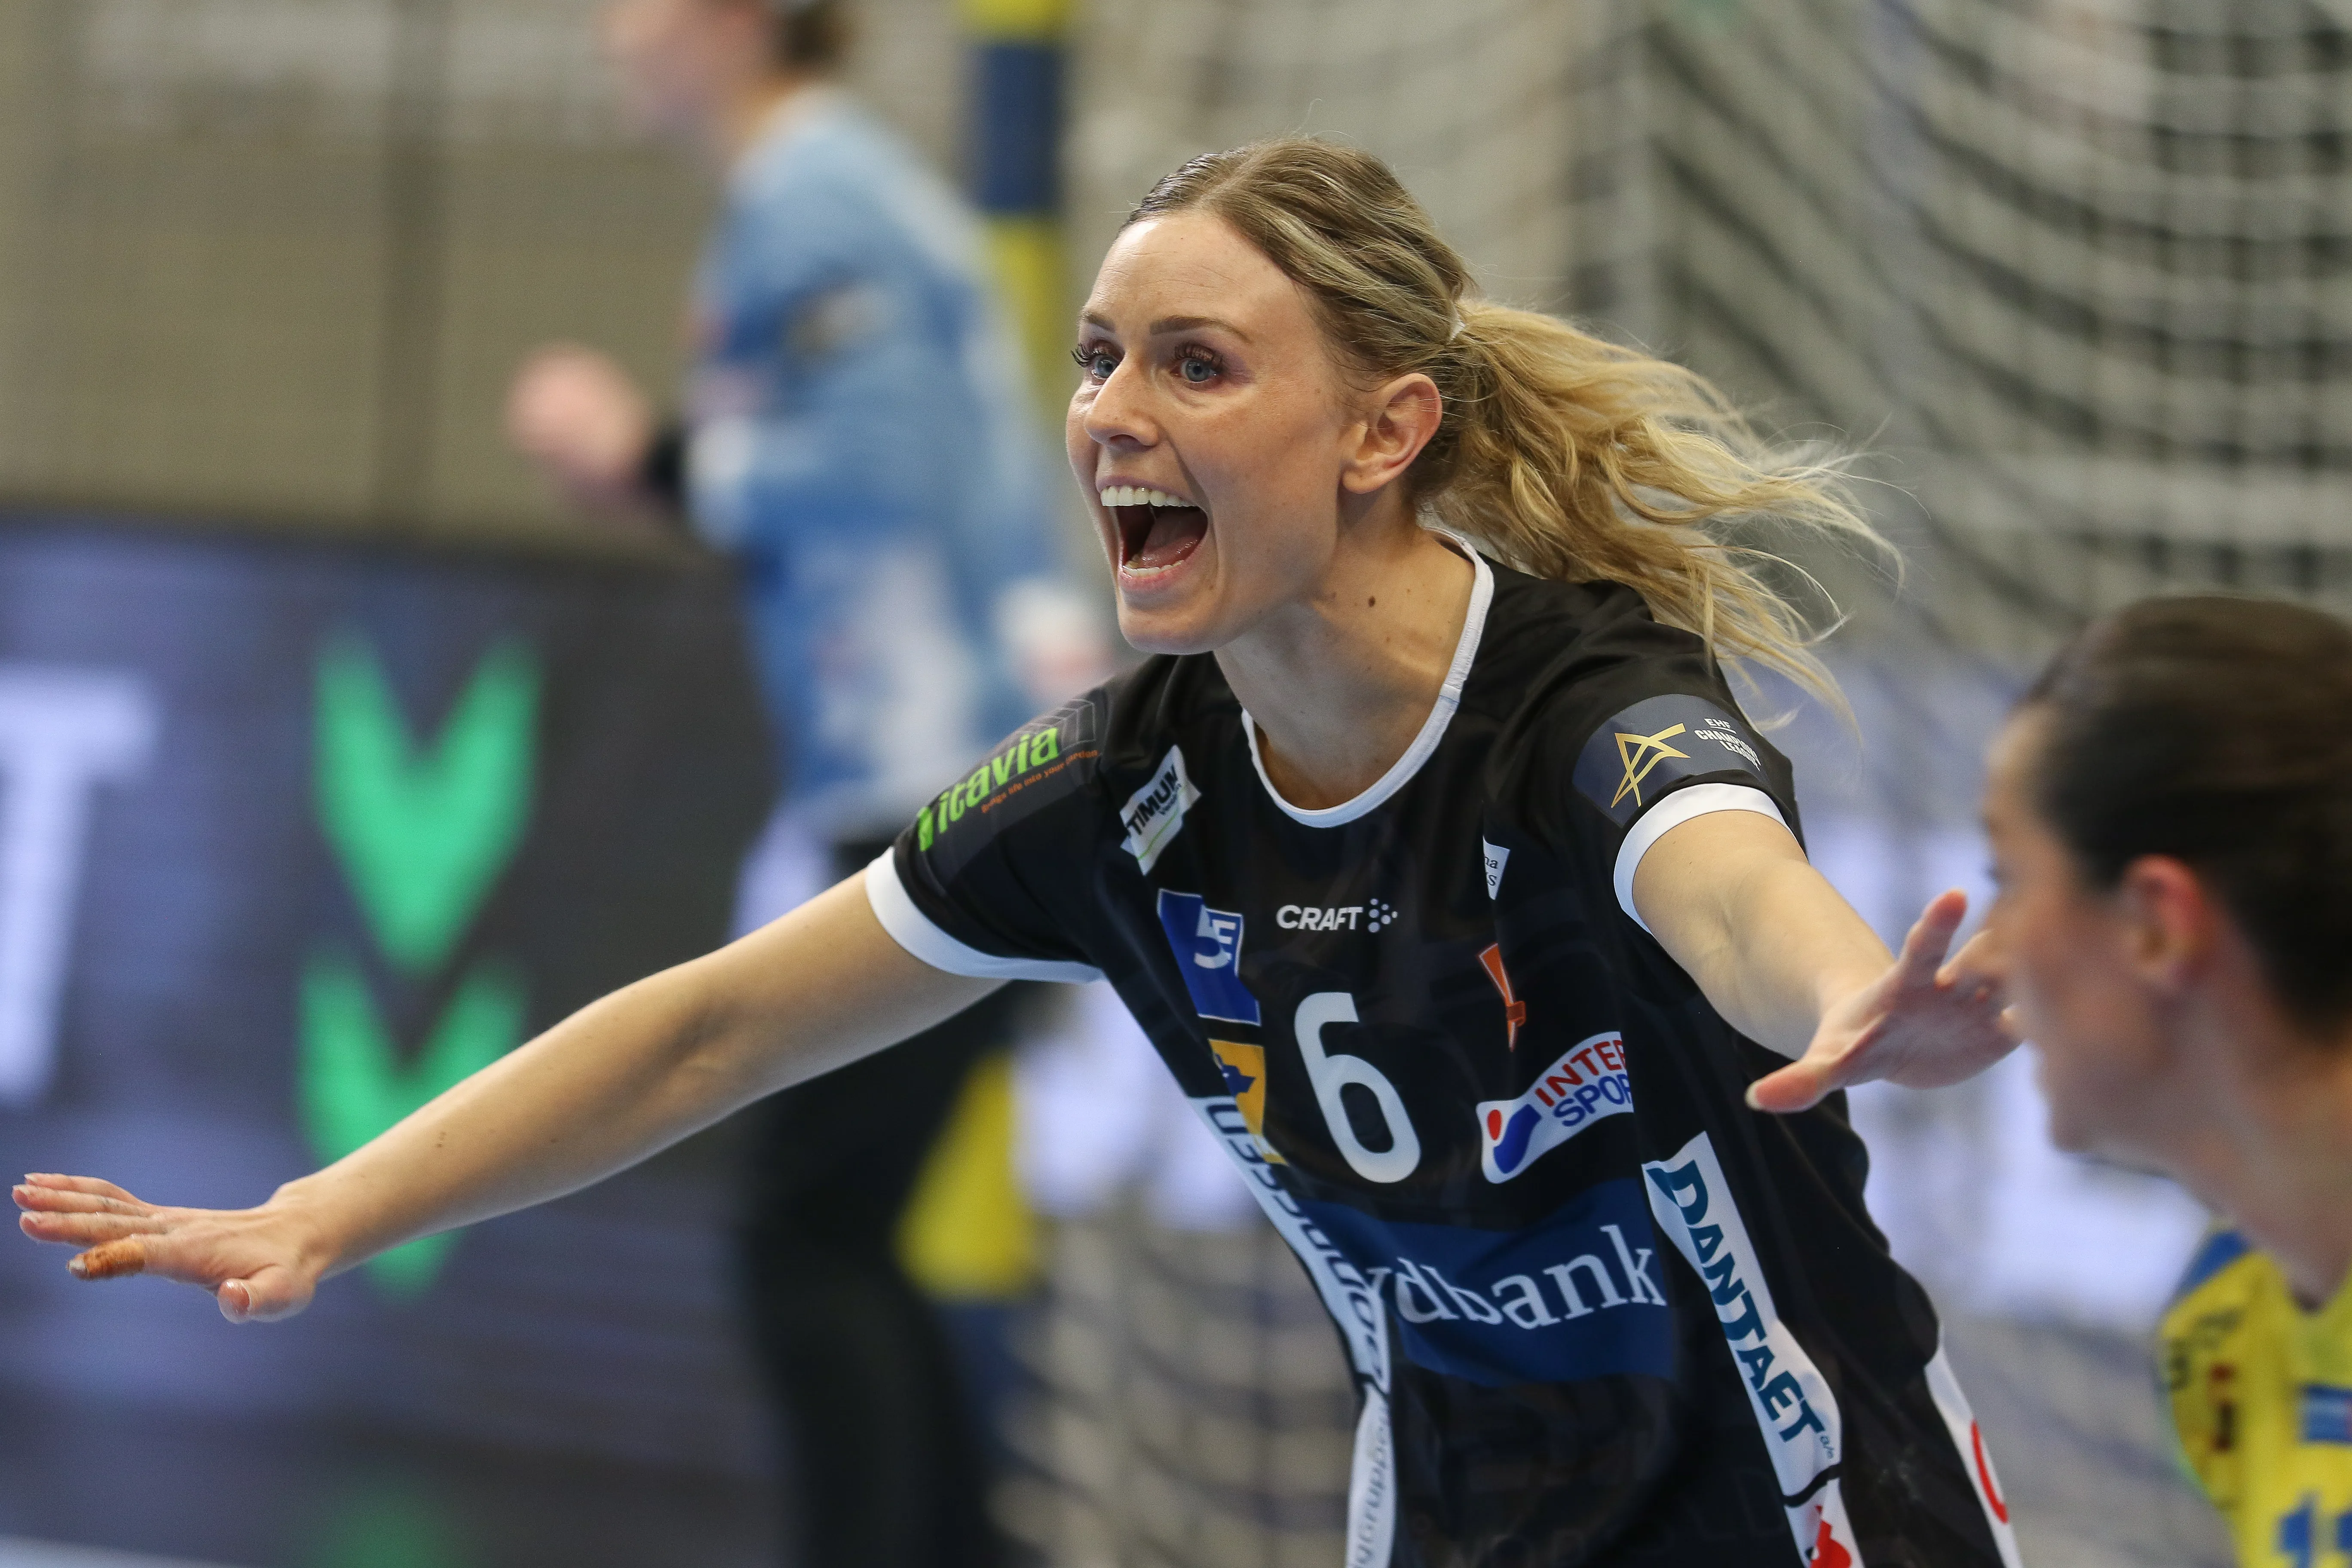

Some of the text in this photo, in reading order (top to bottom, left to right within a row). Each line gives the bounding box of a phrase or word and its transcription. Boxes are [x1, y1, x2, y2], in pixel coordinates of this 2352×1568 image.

[1704, 718, 1731, 729] EHF
[1276, 905, 1363, 931] CRAFT
[1294, 992, 1421, 1184] 6
[1646, 1160, 1825, 1442] DANTAET
